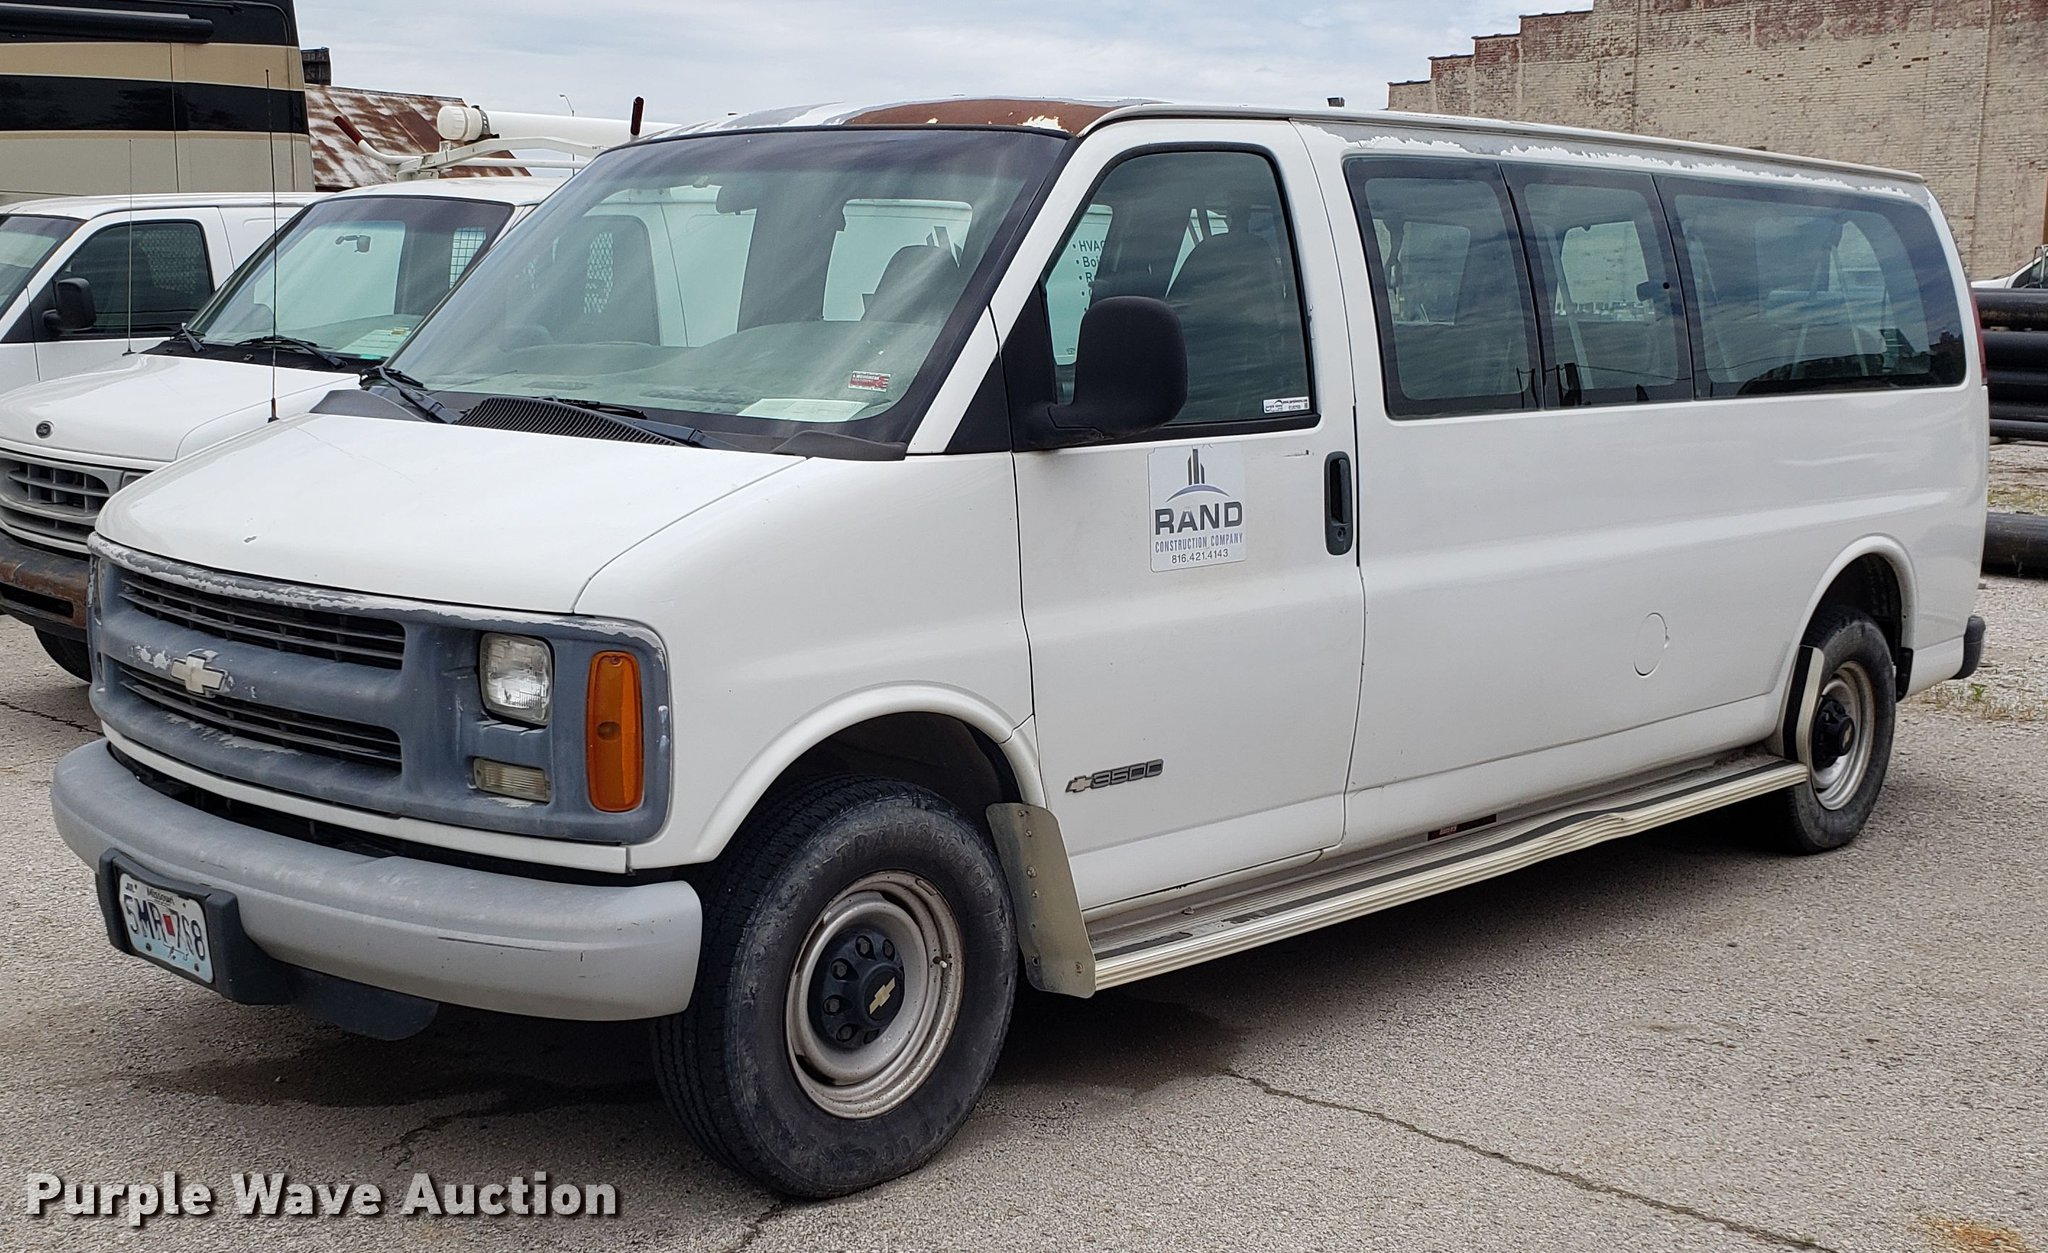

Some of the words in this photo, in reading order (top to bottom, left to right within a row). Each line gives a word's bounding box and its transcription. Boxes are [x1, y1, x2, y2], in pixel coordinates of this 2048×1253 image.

[1155, 501, 1242, 535] RAND
[1155, 536, 1207, 553] CONSTRUCTION
[1210, 532, 1243, 547] COMPANY
[1171, 548, 1229, 564] 816.421.4143
[1091, 759, 1164, 789] 3500
